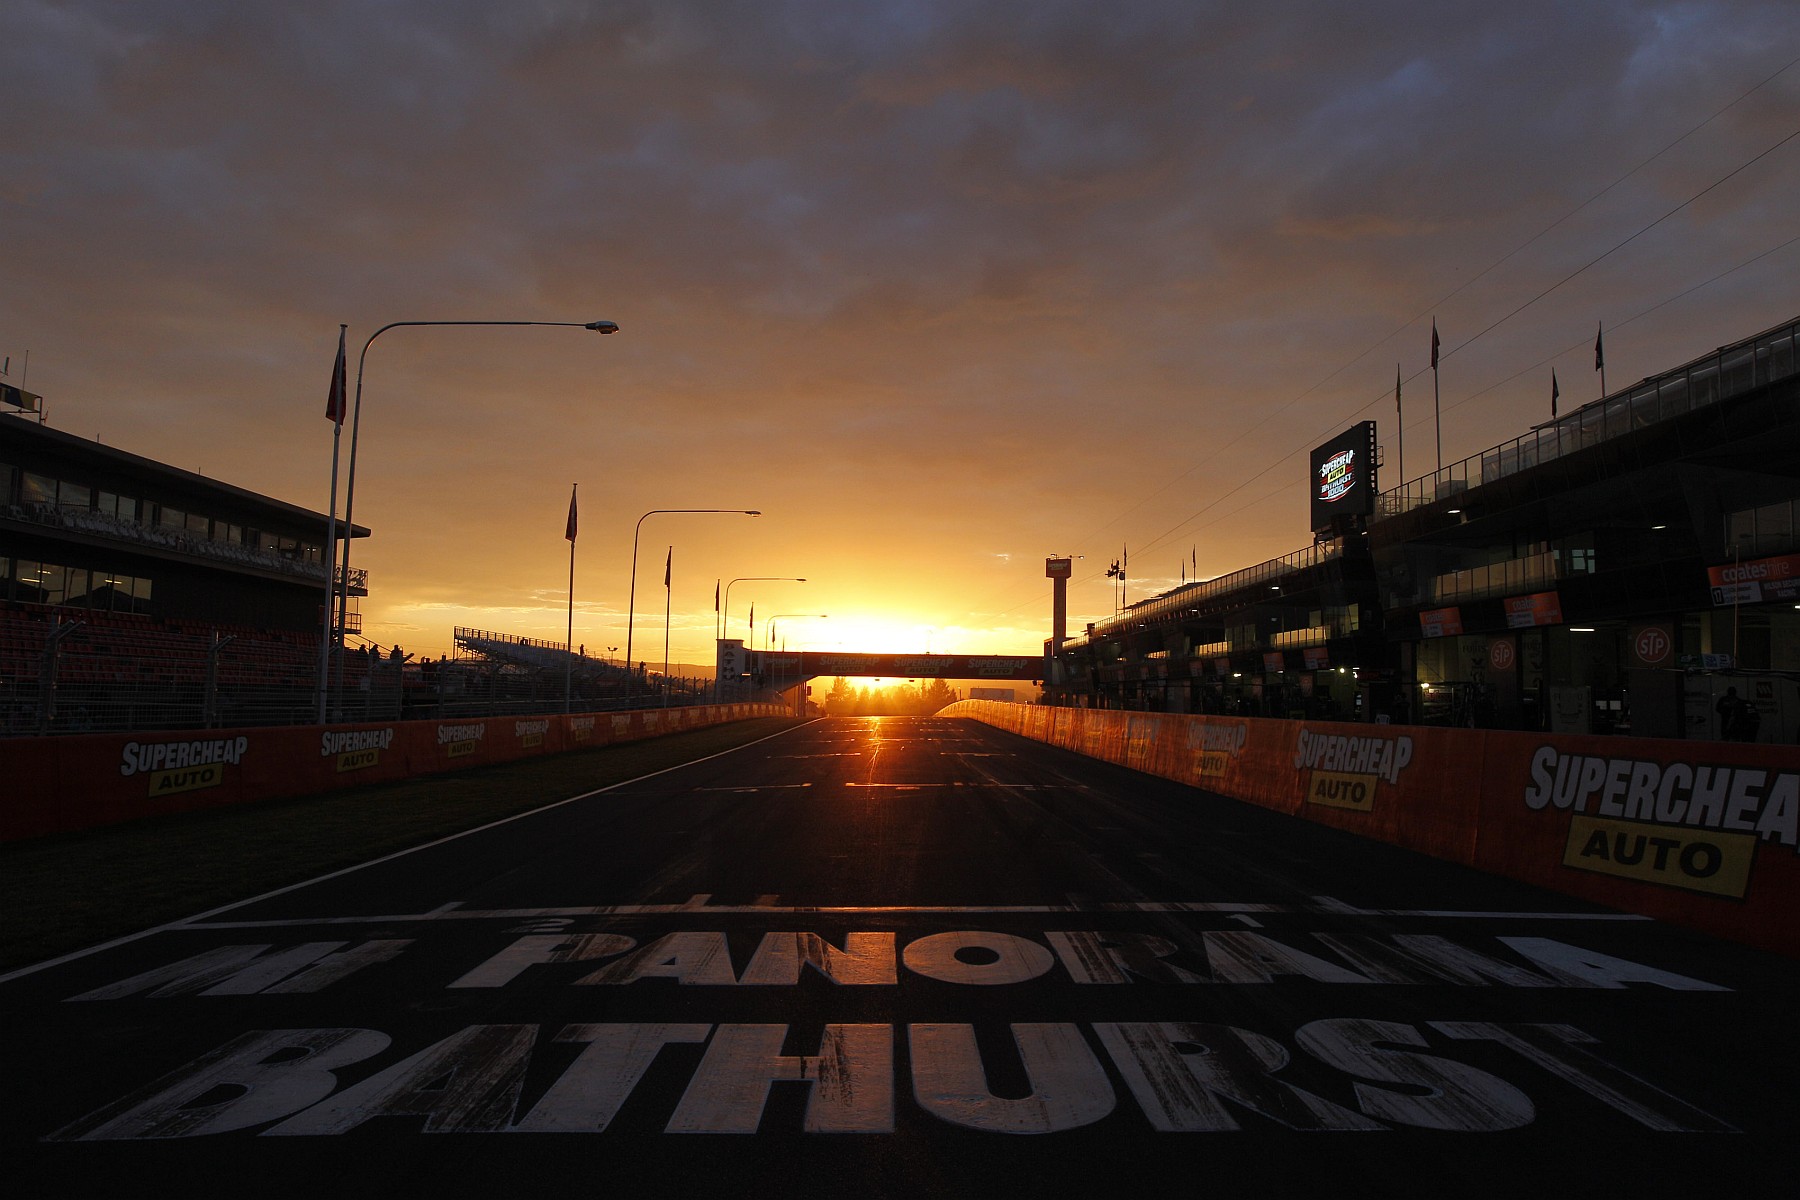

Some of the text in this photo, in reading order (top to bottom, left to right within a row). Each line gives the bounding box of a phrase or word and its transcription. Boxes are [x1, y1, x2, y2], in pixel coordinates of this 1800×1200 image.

[1330, 467, 1344, 480] AUTO
[1494, 645, 1510, 664] STP
[1640, 632, 1665, 656] STP
[819, 655, 880, 667] SUPERCHEAP
[893, 657, 954, 668] SUPERCHEAP
[968, 658, 1028, 669] SUPERCHEAP
[321, 728, 394, 757] SUPERCHEAP
[437, 722, 485, 745] SUPERCHEAP
[120, 736, 247, 777] SUPERCHEAP
[342, 752, 375, 768] AUTO
[451, 743, 473, 754] AUTO
[1294, 729, 1412, 785] SUPERCHEAP
[158, 768, 214, 790] AUTO
[1315, 779, 1366, 803] AUTO
[1525, 746, 1800, 854] SUPERCHEA
[1580, 829, 1722, 878] AUTO
[446, 930, 1736, 992] PANORAMA
[38, 1017, 1745, 1143] BATHURST
